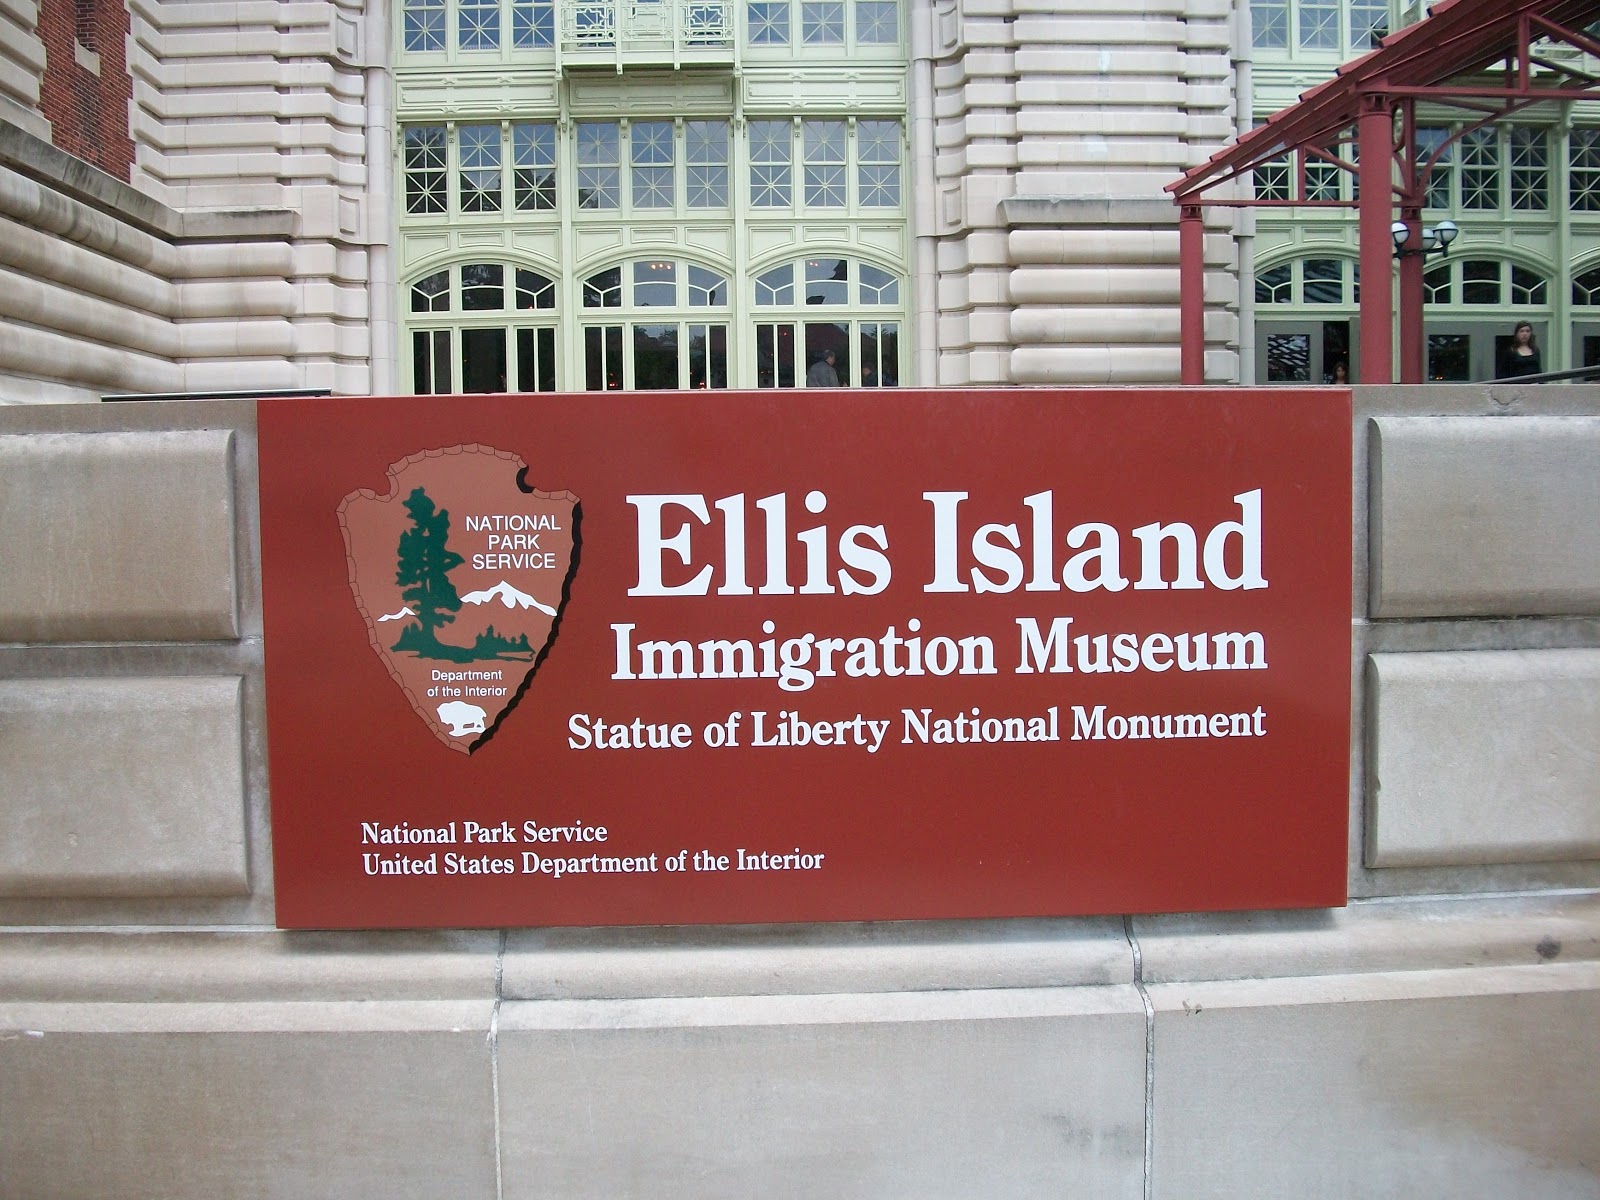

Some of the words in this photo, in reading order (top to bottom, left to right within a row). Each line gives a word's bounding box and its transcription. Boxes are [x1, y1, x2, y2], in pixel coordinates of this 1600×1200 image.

[465, 515, 561, 531] NATIONAL
[488, 534, 540, 550] PARK
[626, 491, 891, 596] Ellis
[923, 489, 1268, 593] Island
[472, 553, 556, 569] SERVICE
[611, 619, 997, 691] Immigration
[1015, 617, 1268, 673] Museum
[431, 670, 502, 684] Department
[427, 686, 439, 697] of
[441, 686, 461, 697] the
[465, 686, 507, 697] Interior
[568, 714, 692, 749] Statue
[704, 712, 741, 747] of
[751, 711, 890, 754] Liberty
[901, 707, 1060, 743] National
[1071, 706, 1266, 741] Monument
[361, 822, 456, 843] National
[463, 822, 517, 843] Park
[524, 820, 607, 842] Service
[362, 853, 437, 875] United
[445, 853, 514, 874] States
[521, 852, 658, 878] Department
[665, 850, 687, 871] of
[692, 850, 729, 871] the
[737, 848, 824, 870] Interior
